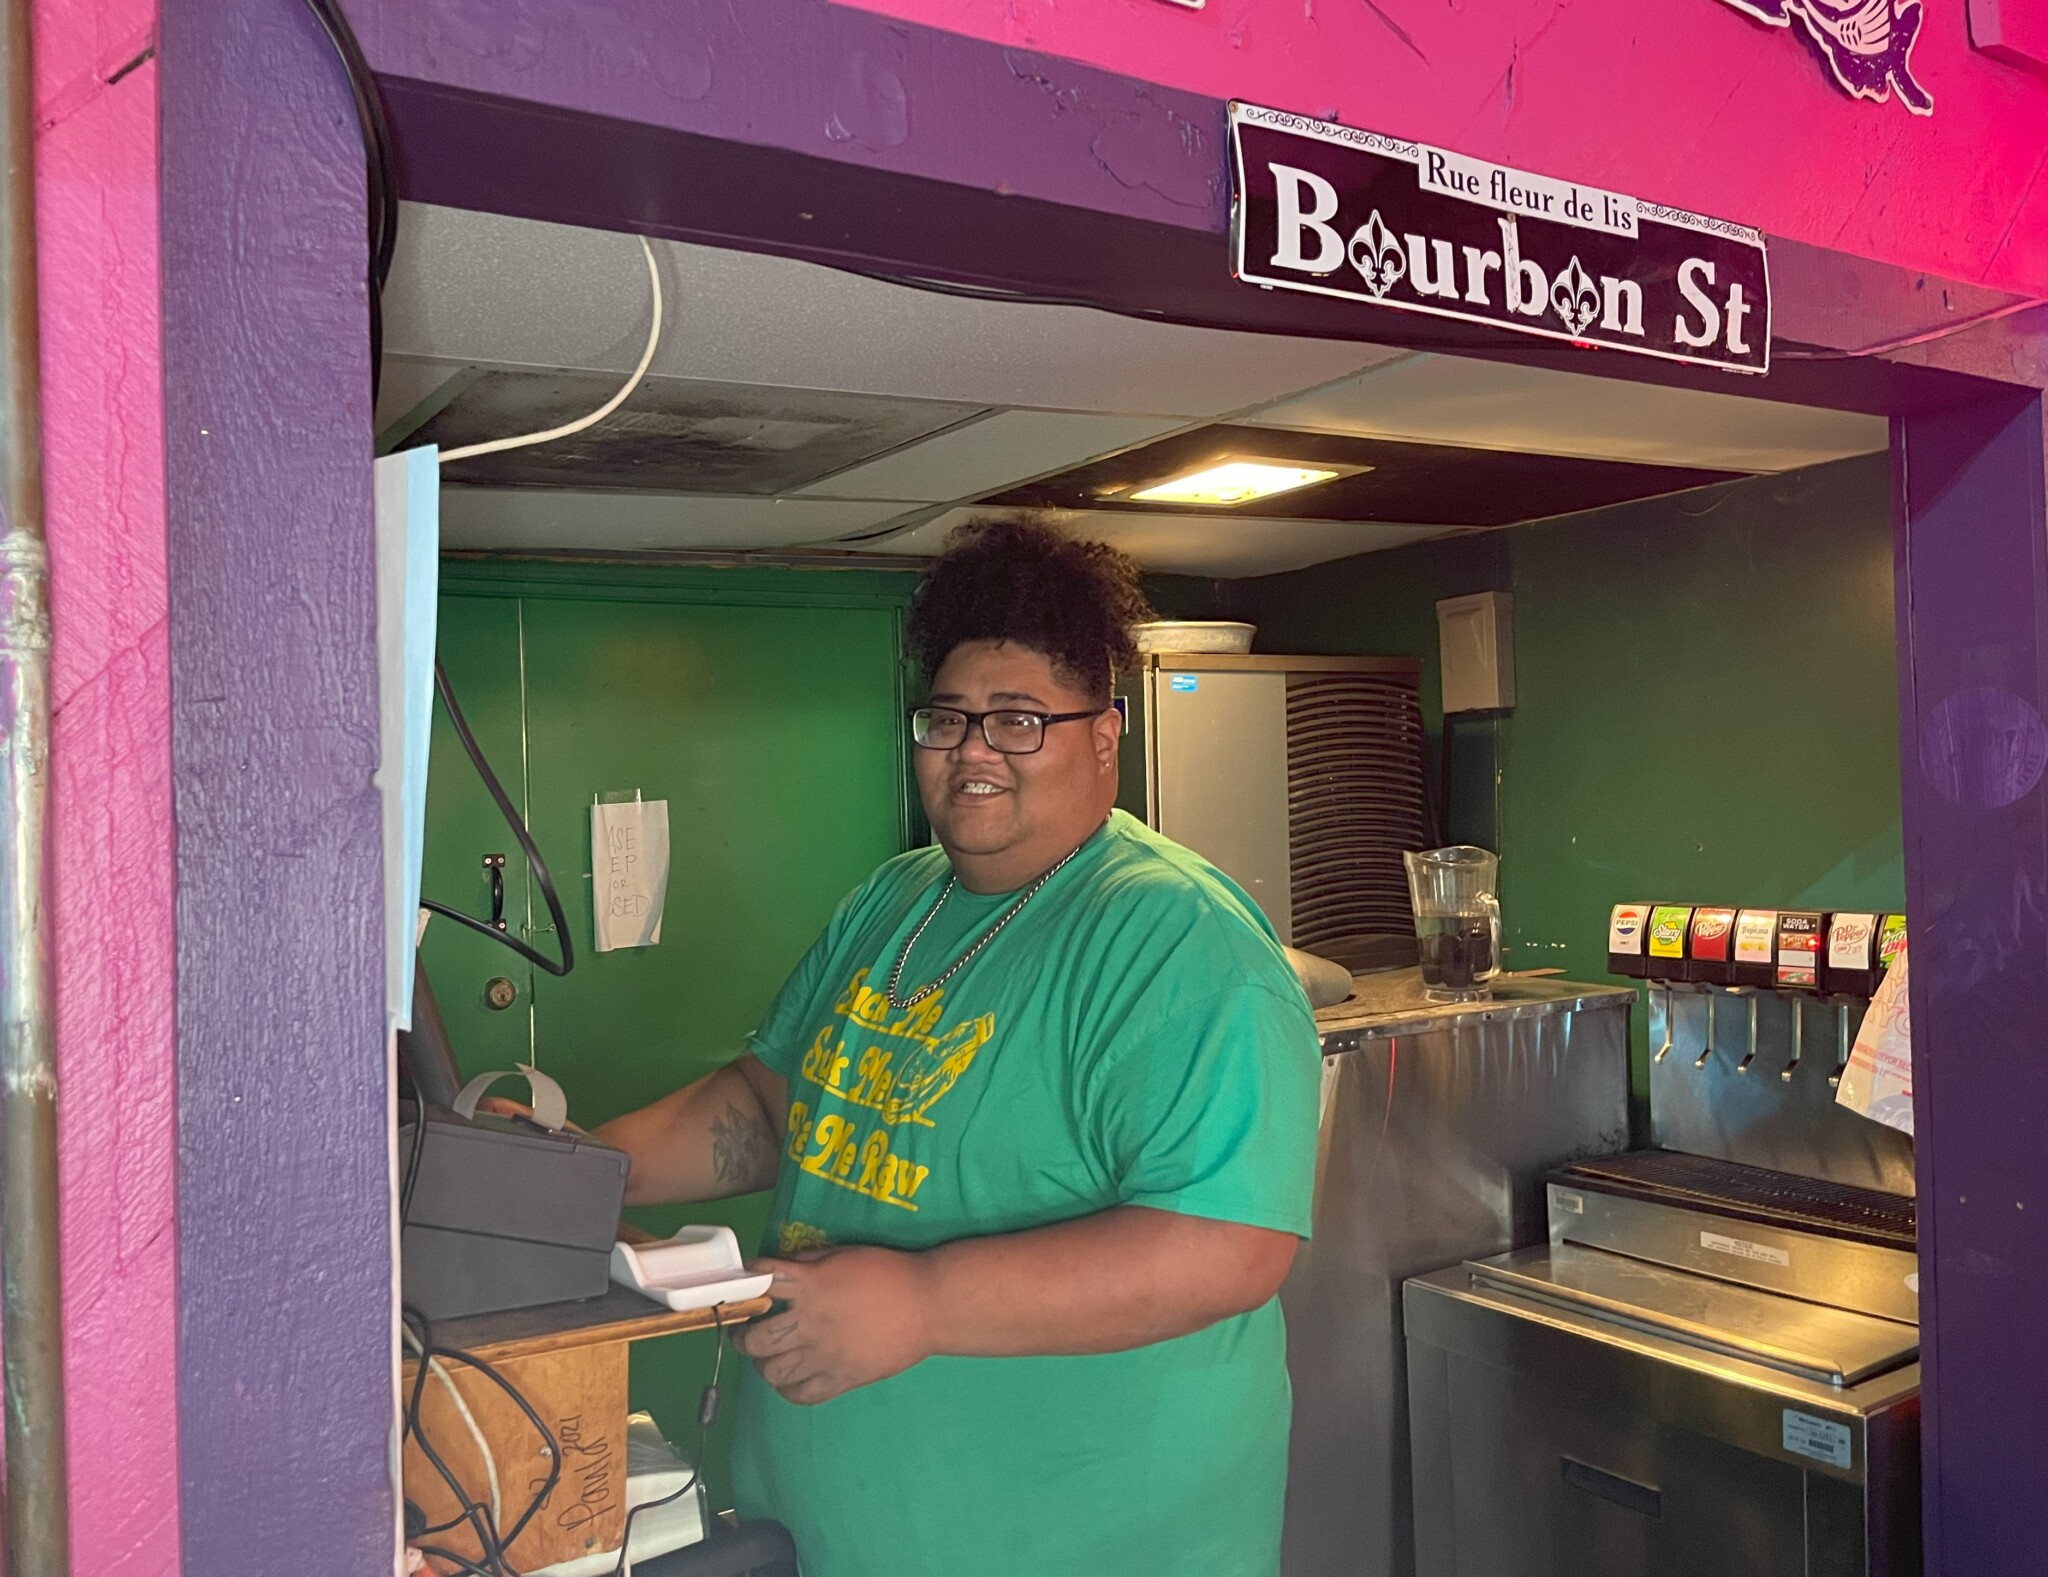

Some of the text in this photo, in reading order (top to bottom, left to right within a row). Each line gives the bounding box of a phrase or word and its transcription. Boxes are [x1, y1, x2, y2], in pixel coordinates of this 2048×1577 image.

[1427, 150, 1632, 231] Rue fleur de lis
[1674, 257, 1751, 354] St
[1616, 919, 1639, 927] PEPSI
[1834, 926, 1866, 942] Pepper
[1846, 924, 1859, 933] Dr
[557, 1414, 617, 1531] Paula 2021
